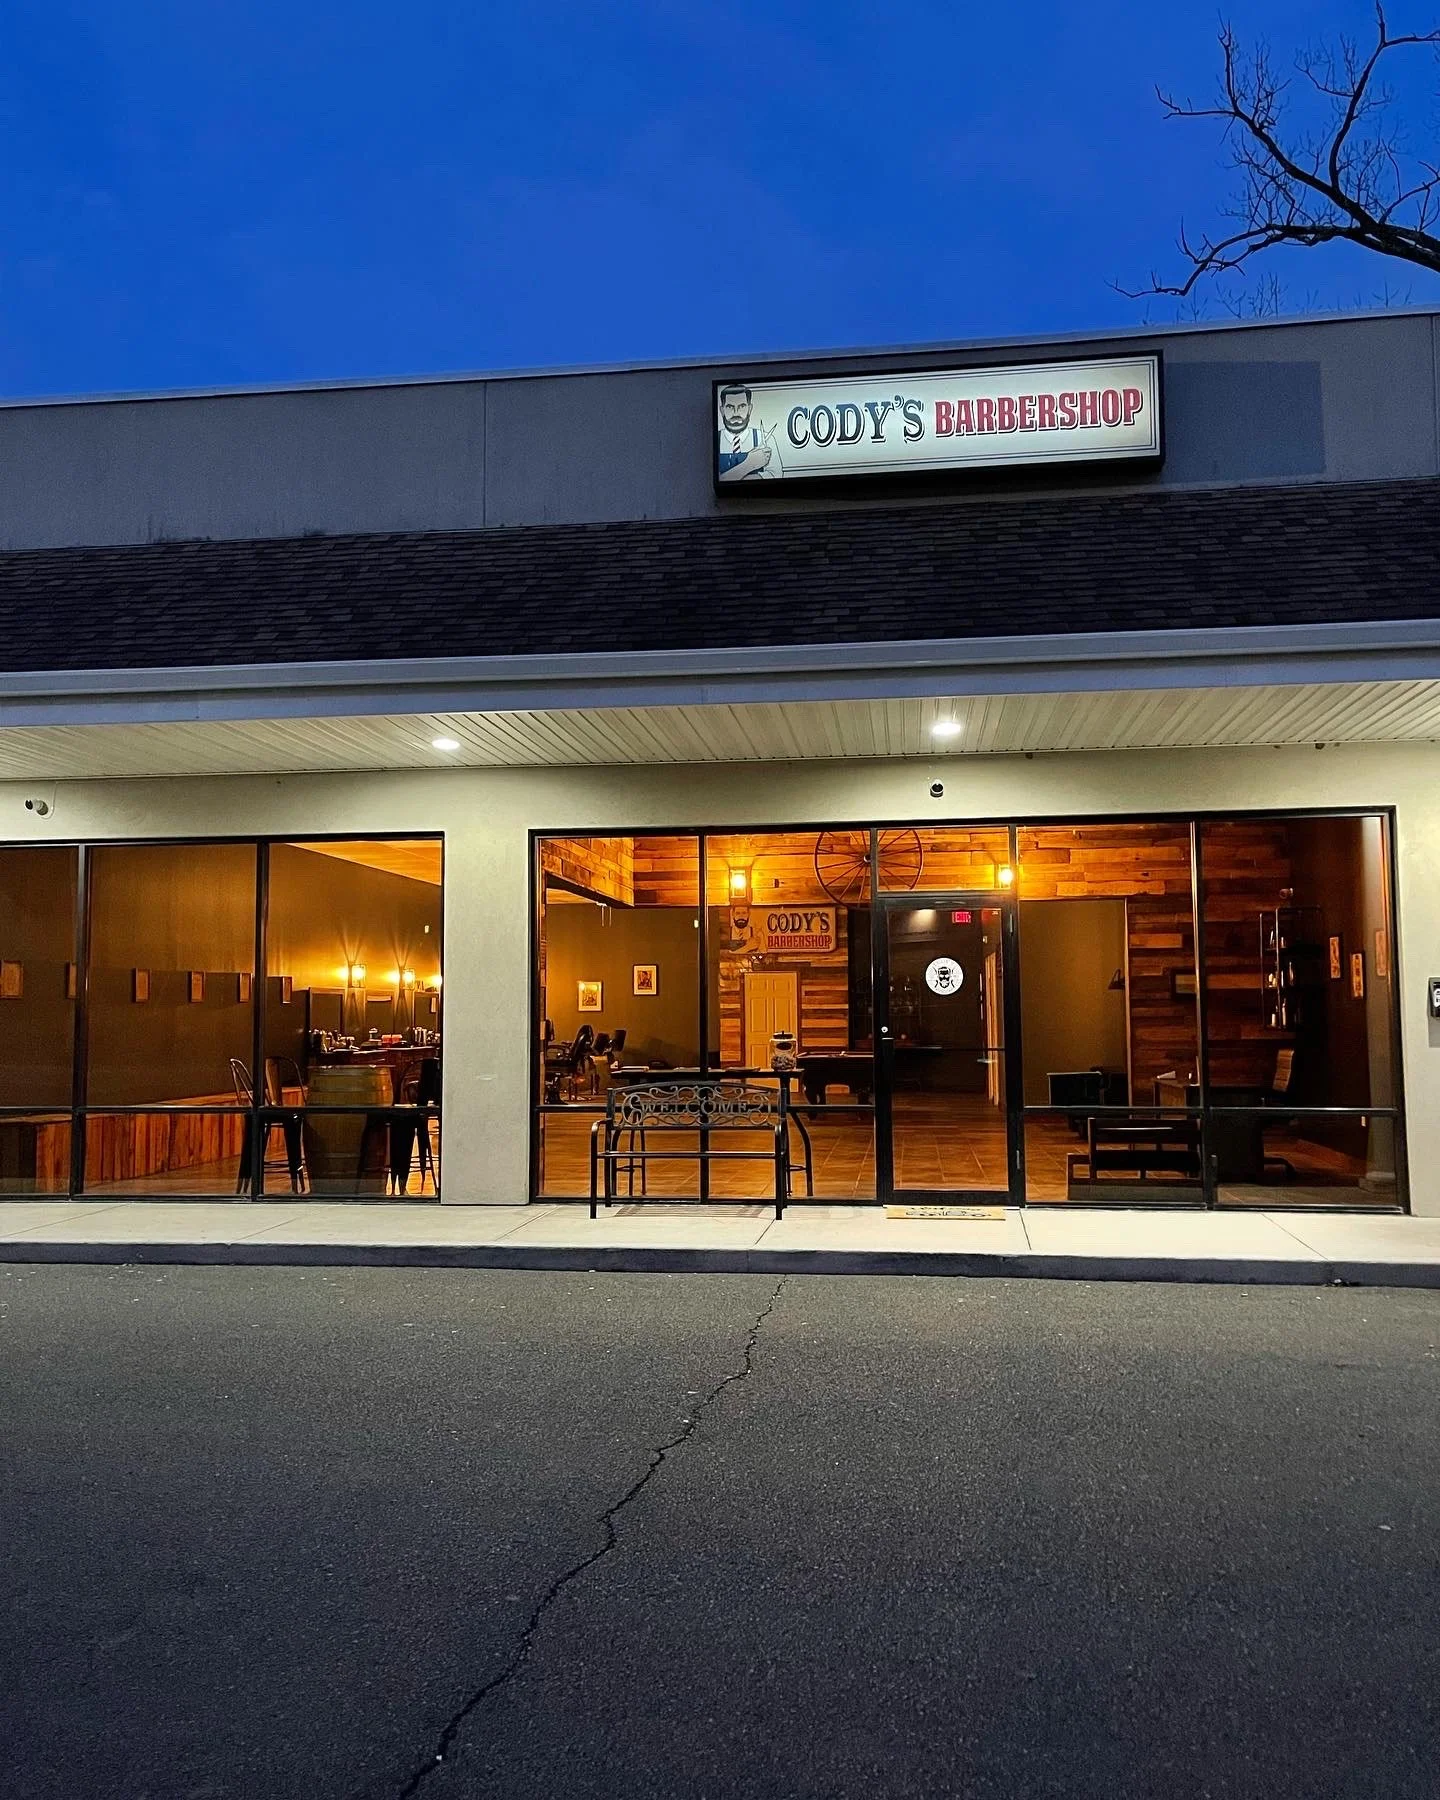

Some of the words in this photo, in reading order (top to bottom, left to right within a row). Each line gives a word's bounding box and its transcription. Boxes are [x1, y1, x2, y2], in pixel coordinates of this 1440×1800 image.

[787, 395, 925, 449] CODY'S
[935, 388, 1142, 437] BARBERSHOP
[767, 911, 830, 934] CODY'S
[767, 934, 832, 949] BARBERSHOP
[641, 1100, 750, 1115] WELCOME
